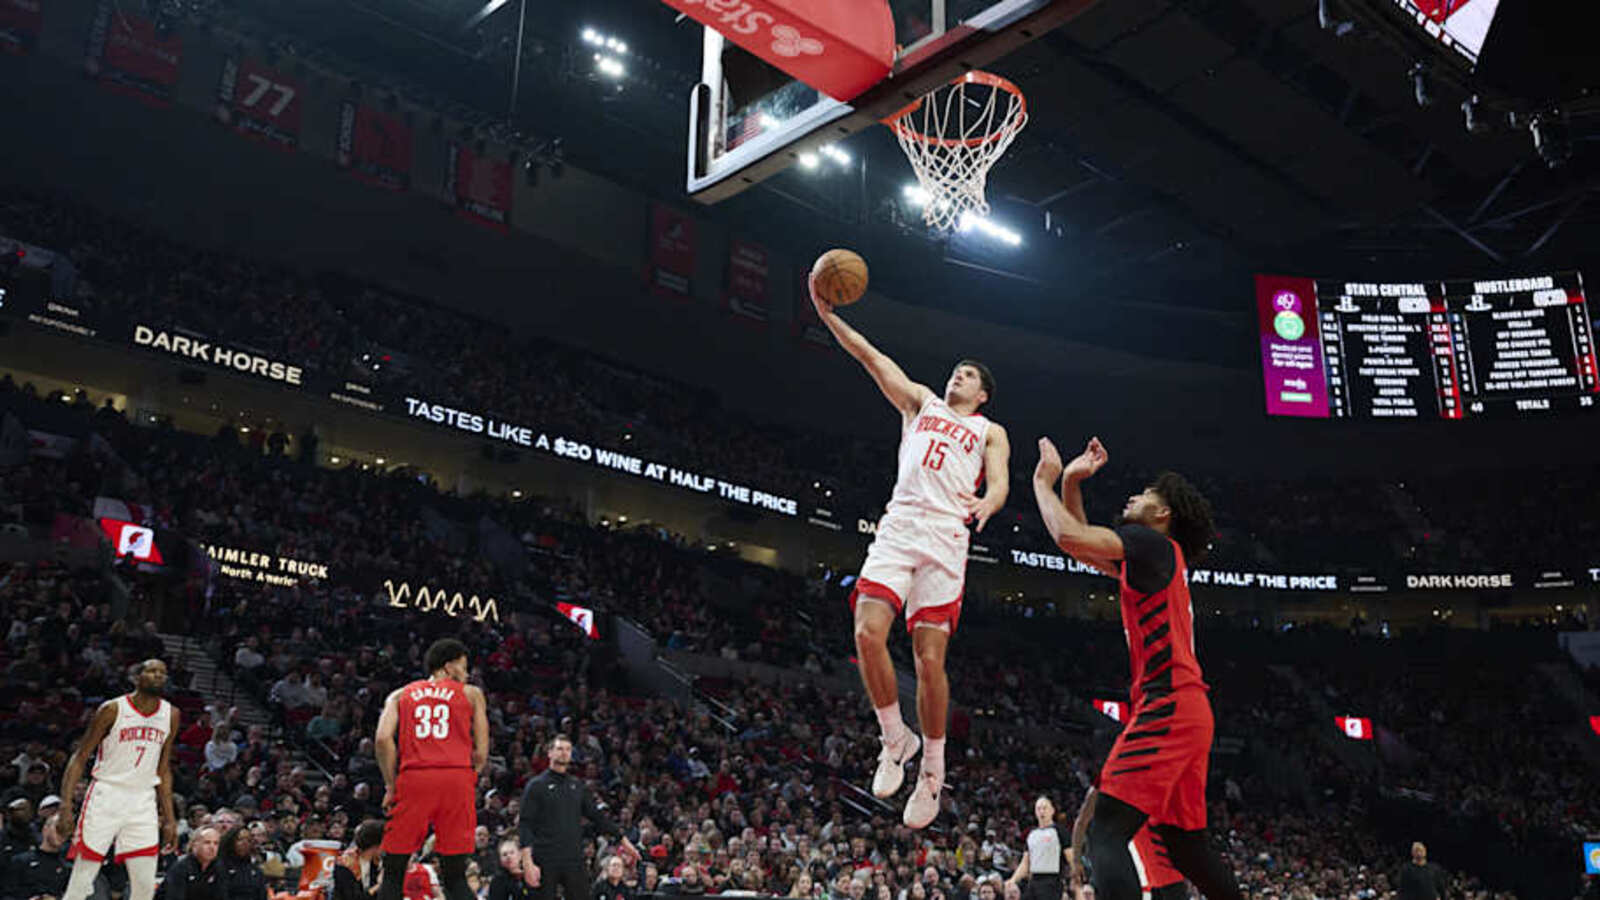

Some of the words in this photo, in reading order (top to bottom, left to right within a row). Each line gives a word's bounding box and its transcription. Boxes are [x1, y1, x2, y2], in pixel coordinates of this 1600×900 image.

[685, 0, 773, 34] Sta
[242, 73, 295, 116] 77
[1345, 283, 1378, 296] STATS
[1379, 284, 1427, 297] CENTRAL
[1473, 277, 1553, 294] HUSTLEBOARD
[135, 326, 210, 360] DARK
[214, 347, 302, 385] HORSE
[915, 415, 978, 454] ROCKETS
[405, 398, 484, 432] TASTES
[488, 421, 532, 446] LIKE
[535, 434, 550, 450] A
[554, 437, 592, 460] $20
[595, 448, 642, 474] WINE
[645, 463, 668, 480] AT
[670, 468, 715, 492] HALF
[718, 481, 750, 503] THE
[752, 491, 797, 515] PRICE
[921, 439, 949, 471] 15
[857, 519, 877, 534] DA
[200, 544, 270, 568] AIMLER
[278, 558, 328, 578] TRUCK
[1011, 550, 1065, 569] TASTES
[220, 565, 252, 580] North
[1192, 570, 1212, 583] AT
[1214, 572, 1254, 586] HALF
[1257, 574, 1287, 588] THE
[1289, 576, 1337, 589] PRICE
[1406, 575, 1453, 588] DARK
[1455, 574, 1513, 588] HORSE
[414, 704, 450, 740] 33
[119, 727, 163, 744] ROCKETS
[135, 746, 146, 767] 7
